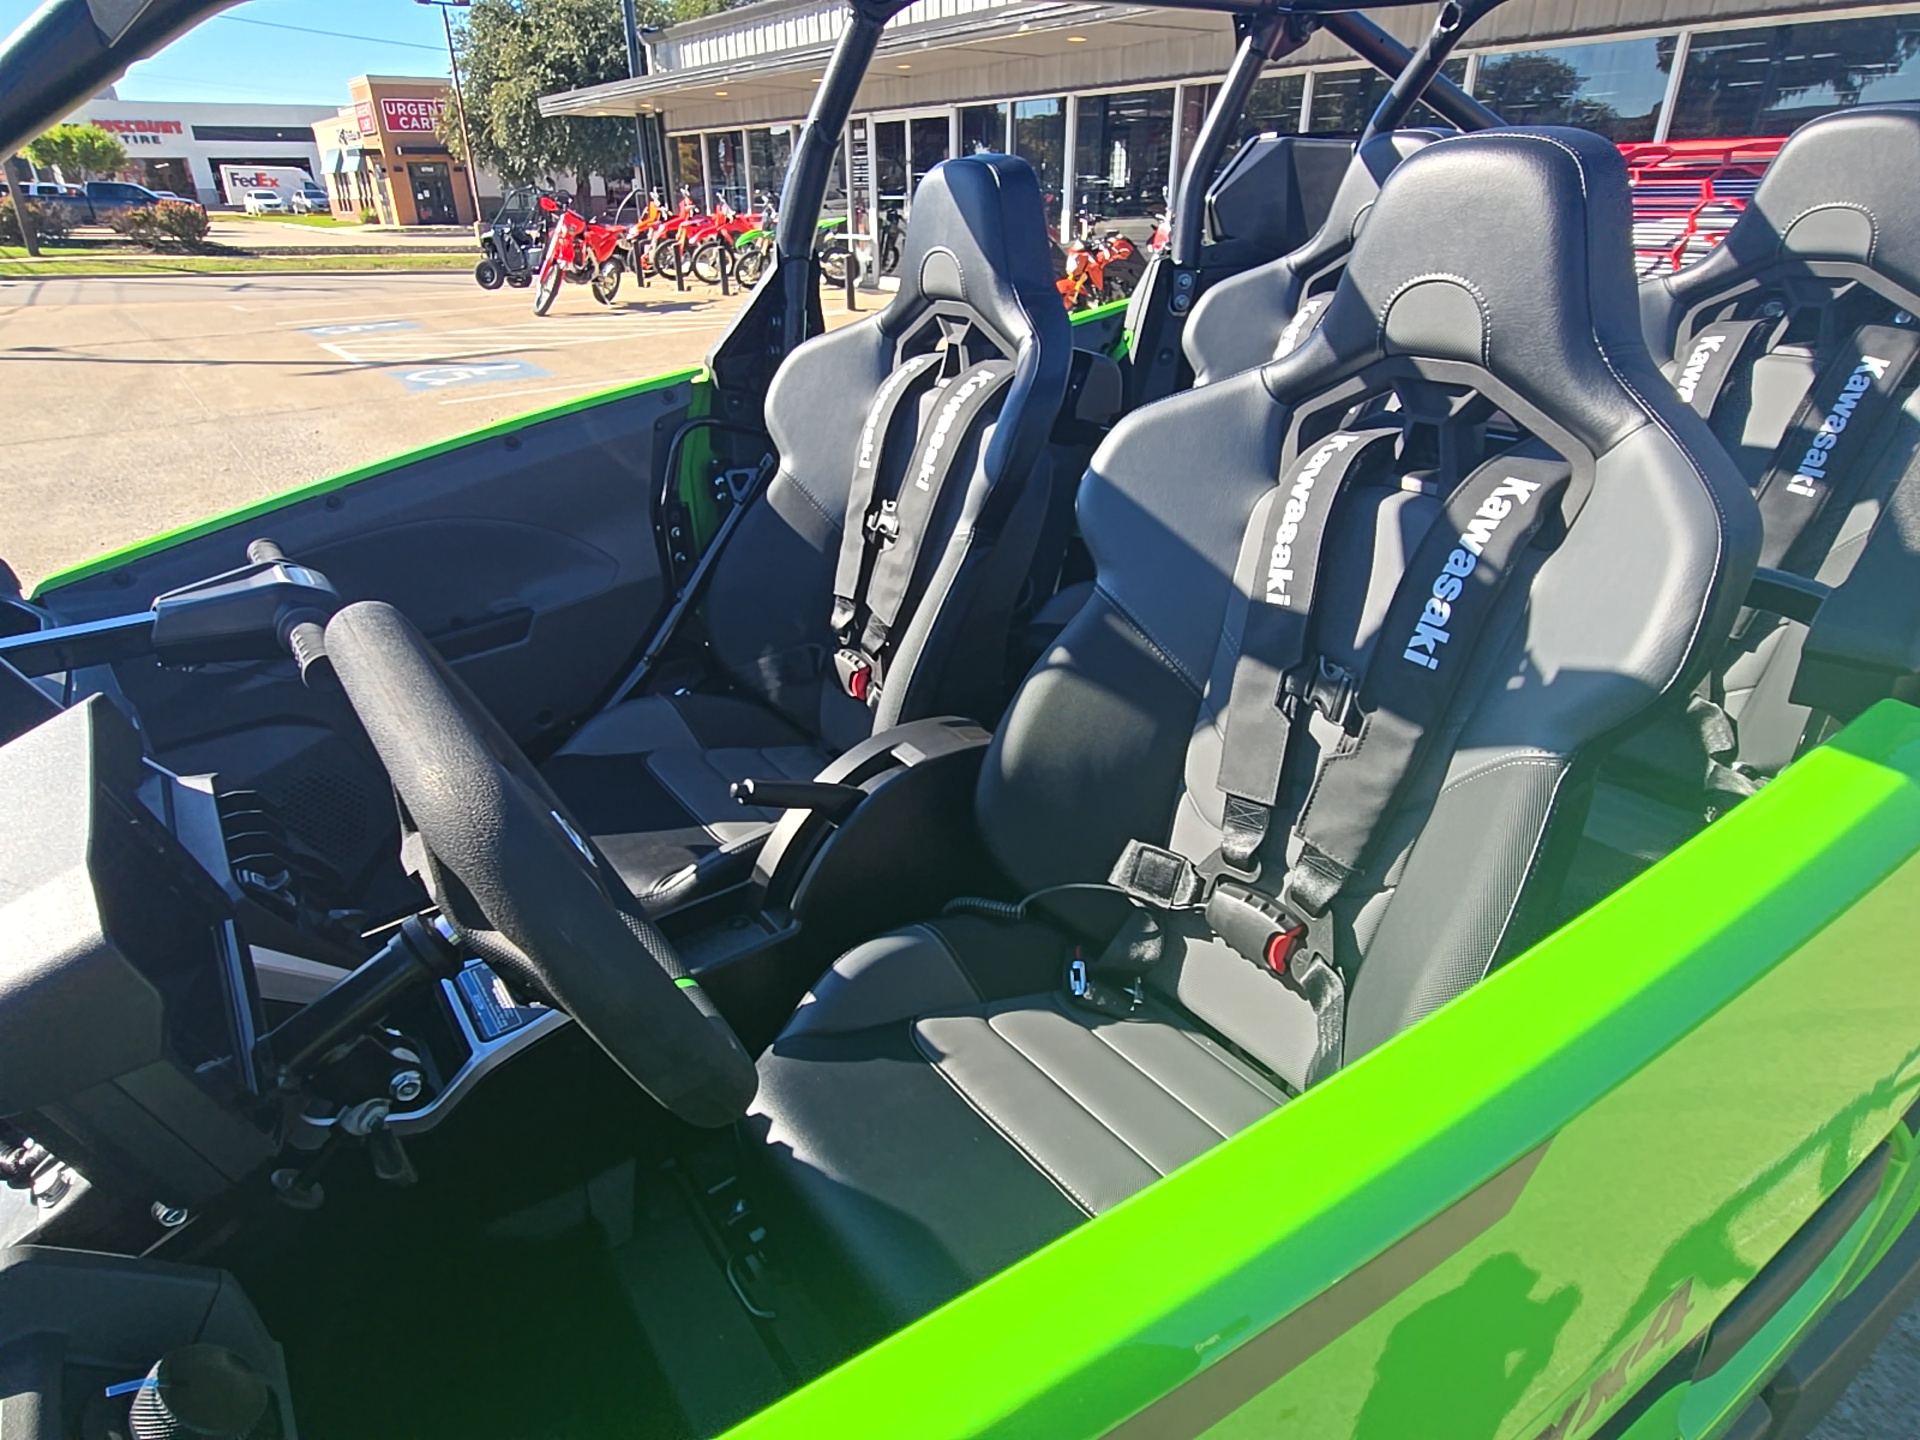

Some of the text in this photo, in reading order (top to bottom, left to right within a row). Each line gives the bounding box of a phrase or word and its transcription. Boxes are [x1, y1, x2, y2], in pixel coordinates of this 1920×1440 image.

[121, 134, 162, 144] TIRE
[230, 172, 280, 188] FedEx
[915, 369, 996, 492] Kawasaki
[1786, 355, 1891, 498] Kawasaki
[1265, 435, 1360, 607] Kawasaki
[1403, 476, 1541, 671] Kawasaki
